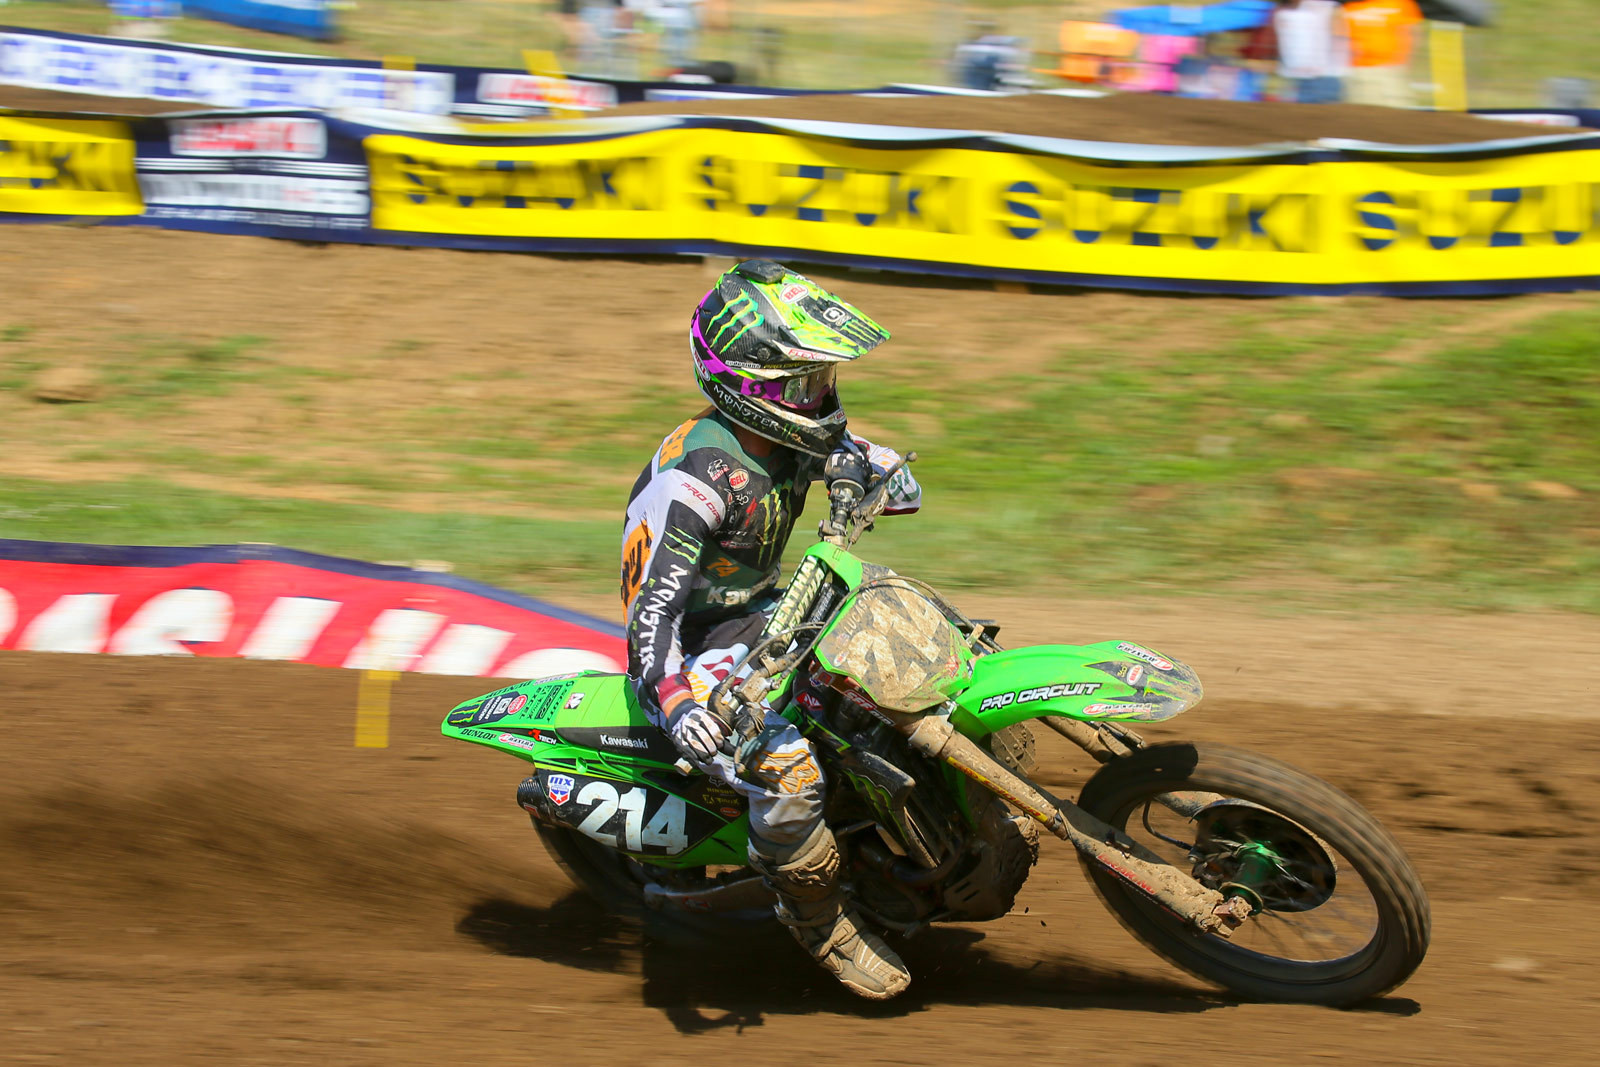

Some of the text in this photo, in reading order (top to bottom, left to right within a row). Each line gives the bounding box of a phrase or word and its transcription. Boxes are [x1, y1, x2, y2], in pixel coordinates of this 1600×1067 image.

[692, 154, 966, 235] SUZUKI
[998, 180, 1316, 254] SUZUKI
[1352, 184, 1600, 251] SUZU
[713, 384, 779, 431] MONSTER
[681, 482, 706, 502] PRO
[844, 598, 870, 635] LUCAS
[980, 683, 1102, 713] PRO CIRCUIT
[460, 728, 496, 741] DUNLOP
[600, 734, 649, 749] Kawasaki
[576, 781, 688, 855] 214
